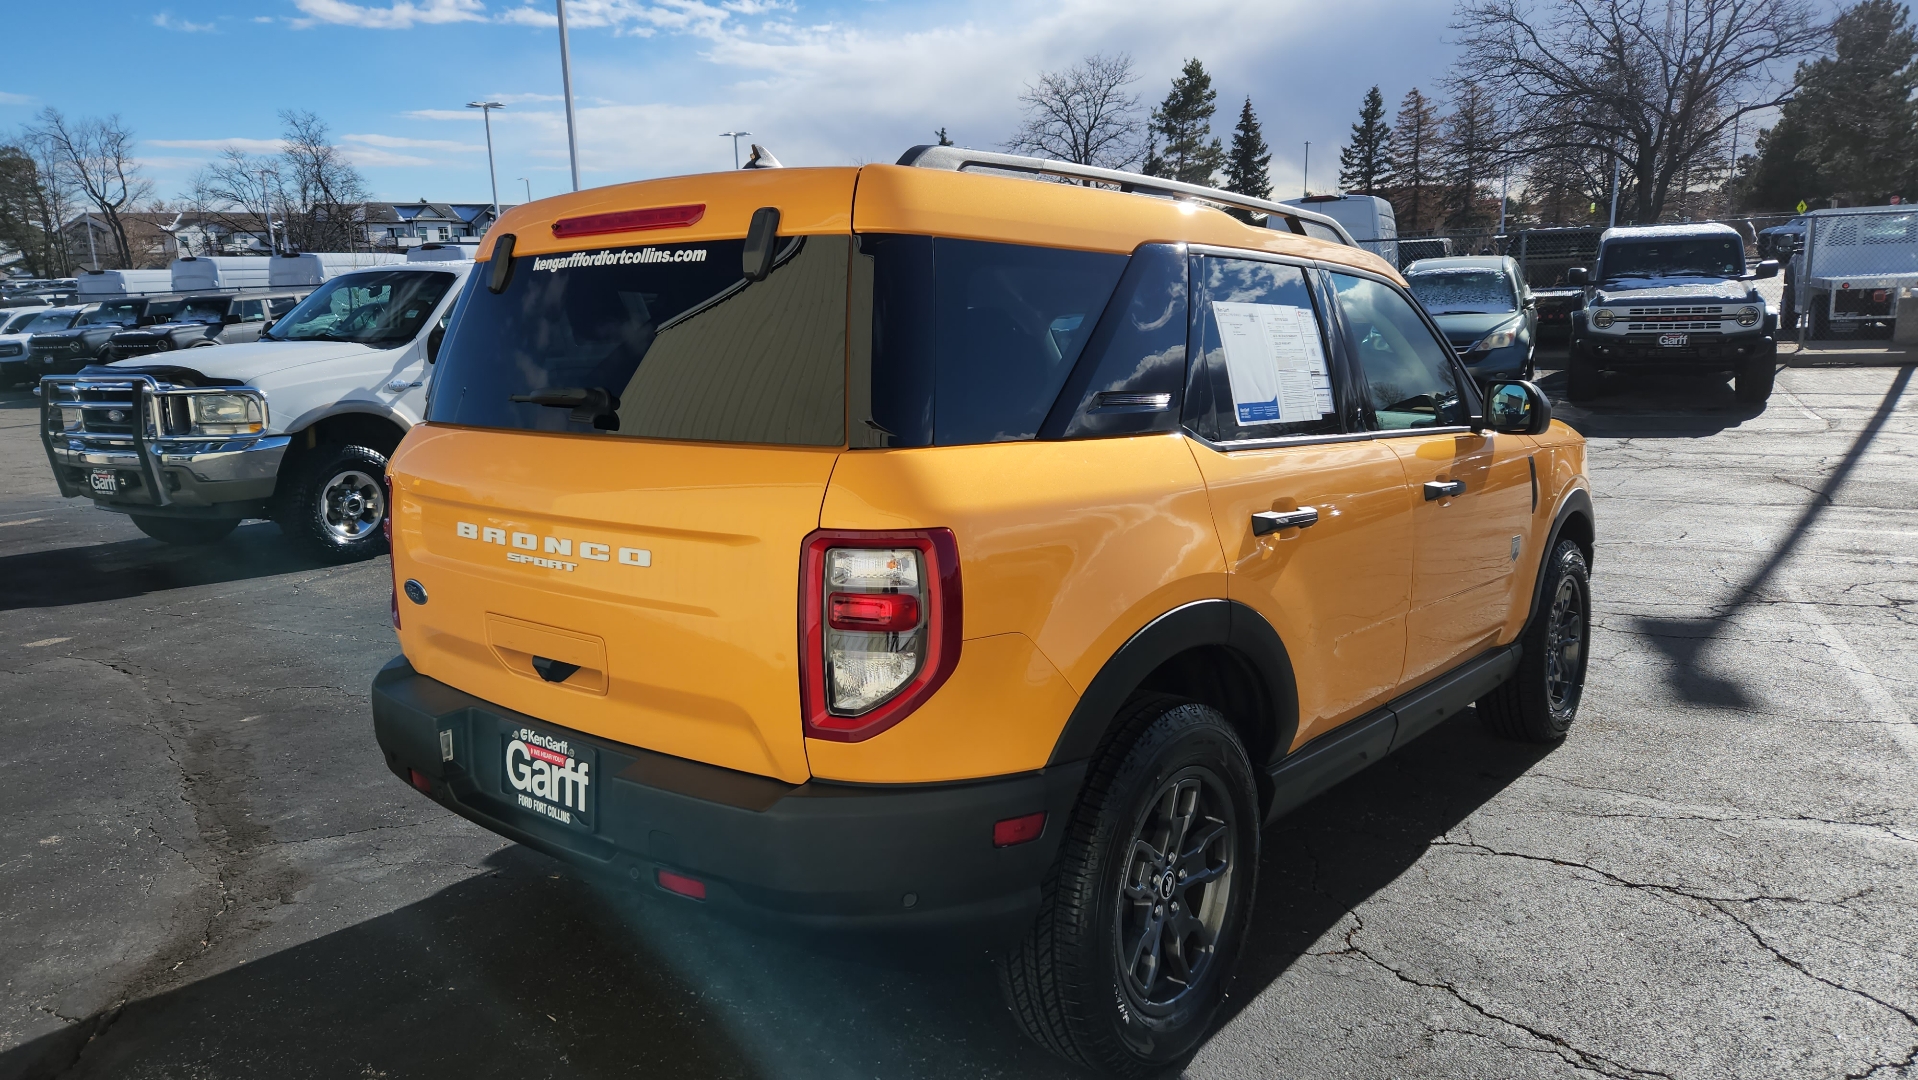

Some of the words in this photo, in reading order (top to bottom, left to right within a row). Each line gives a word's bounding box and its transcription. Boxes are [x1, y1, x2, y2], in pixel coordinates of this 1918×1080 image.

[533, 248, 707, 272] kengarfffordfortcollins.com
[1659, 335, 1688, 345] Garff
[91, 474, 116, 490] Garff
[457, 521, 652, 568] BRONCO
[507, 552, 578, 572] SPORT
[528, 729, 545, 747] Ken
[545, 735, 568, 754] Garff
[506, 740, 589, 812] Garff
[518, 793, 532, 809] FORD
[533, 798, 547, 815] FORT
[547, 805, 571, 825] COLLINS
